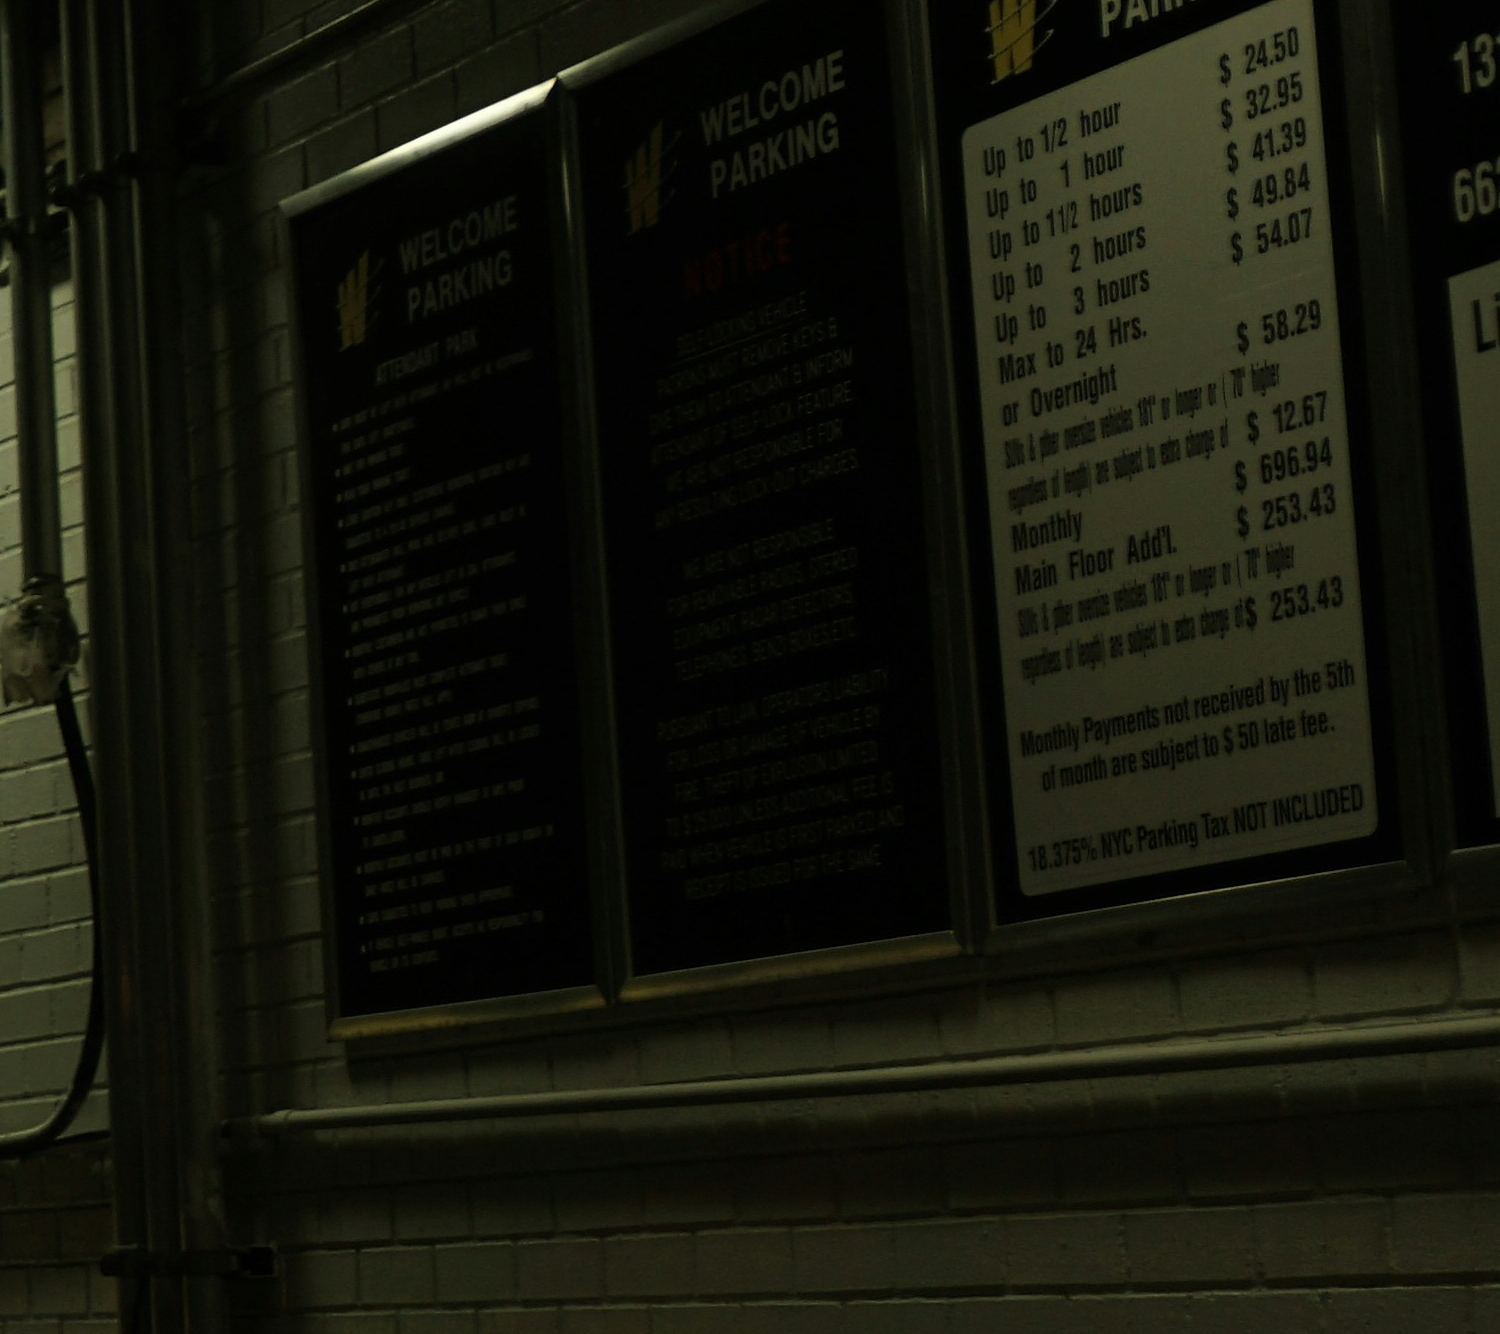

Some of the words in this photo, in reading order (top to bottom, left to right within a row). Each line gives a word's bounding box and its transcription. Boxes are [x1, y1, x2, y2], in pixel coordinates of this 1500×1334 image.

[701, 49, 844, 144] WELCOME
[983, 146, 1005, 178] Up
[1016, 136, 1033, 162] to
[1039, 117, 1067, 152] 1/2
[1079, 102, 1120, 137] hour
[1219, 53, 1231, 85] $
[1244, 26, 1298, 74] 24.50
[1453, 32, 1500, 95] 13
[711, 111, 839, 197] PARKING
[986, 188, 1008, 219] Up
[1019, 178, 1036, 204] to
[1060, 160, 1069, 187] 1
[1083, 145, 1124, 180] hour
[1220, 98, 1232, 131] $
[1245, 71, 1302, 119] 32.95
[988, 229, 1012, 261] Up
[1021, 219, 1039, 246] to
[1089, 182, 1142, 221] hours
[1226, 141, 1238, 174] $
[1252, 117, 1306, 161] 41.39
[399, 195, 516, 273] WELCOME
[992, 271, 1015, 303] Up
[1024, 261, 1042, 288] to
[1070, 243, 1081, 273] 2
[1092, 226, 1146, 264] hours
[1226, 187, 1238, 220] $
[1252, 162, 1310, 207] 49.84
[1453, 157, 1500, 223] 66
[407, 250, 511, 321] PARKING
[683, 219, 794, 294] NOTICE
[995, 312, 1018, 345] Up
[1028, 304, 1046, 330] to
[1073, 285, 1084, 315] 3
[1096, 269, 1149, 307] hours
[1230, 231, 1243, 265] $
[1256, 207, 1311, 254] 54.07
[998, 352, 1036, 384] Max
[1045, 341, 1063, 368] to
[1075, 325, 1096, 359] 24
[1108, 316, 1146, 347] Hrs.
[1002, 401, 1019, 426] or
[1029, 364, 1117, 417] Overnight
[1236, 321, 1249, 355] $
[1262, 299, 1320, 344] 58.29
[1246, 410, 1259, 444] $
[1272, 390, 1326, 433] 12.67
[1011, 509, 1081, 552] Monthly
[1234, 460, 1247, 493] $
[1259, 436, 1332, 484] 696.94
[1014, 560, 1057, 595] Main
[1068, 548, 1114, 580] Floor
[1236, 505, 1249, 539] $
[1262, 483, 1335, 530] 253.43
[1244, 596, 1257, 630] $
[1270, 575, 1343, 621] 253.43
[1019, 722, 1079, 757] Monthly
[1082, 705, 1160, 745] Payments
[1162, 696, 1190, 725] not
[1192, 678, 1265, 719] received
[1269, 676, 1289, 706] by
[1292, 668, 1321, 697] the
[1325, 659, 1355, 690] 5th
[1041, 764, 1055, 791] of
[1059, 754, 1107, 787] month
[1110, 752, 1137, 777] are
[1140, 734, 1200, 770] subject
[1202, 732, 1219, 757] to
[1222, 726, 1234, 754] $
[1237, 721, 1259, 750] 50
[1263, 716, 1295, 744] late
[1299, 709, 1334, 737] fee.
[1027, 837, 1097, 871] 18.375%
[1100, 827, 1132, 858] NYC
[1135, 821, 1198, 851] Parking
[1200, 812, 1229, 839] Tax
[1232, 801, 1267, 833] NOT
[1272, 783, 1363, 826] INCLUDED
